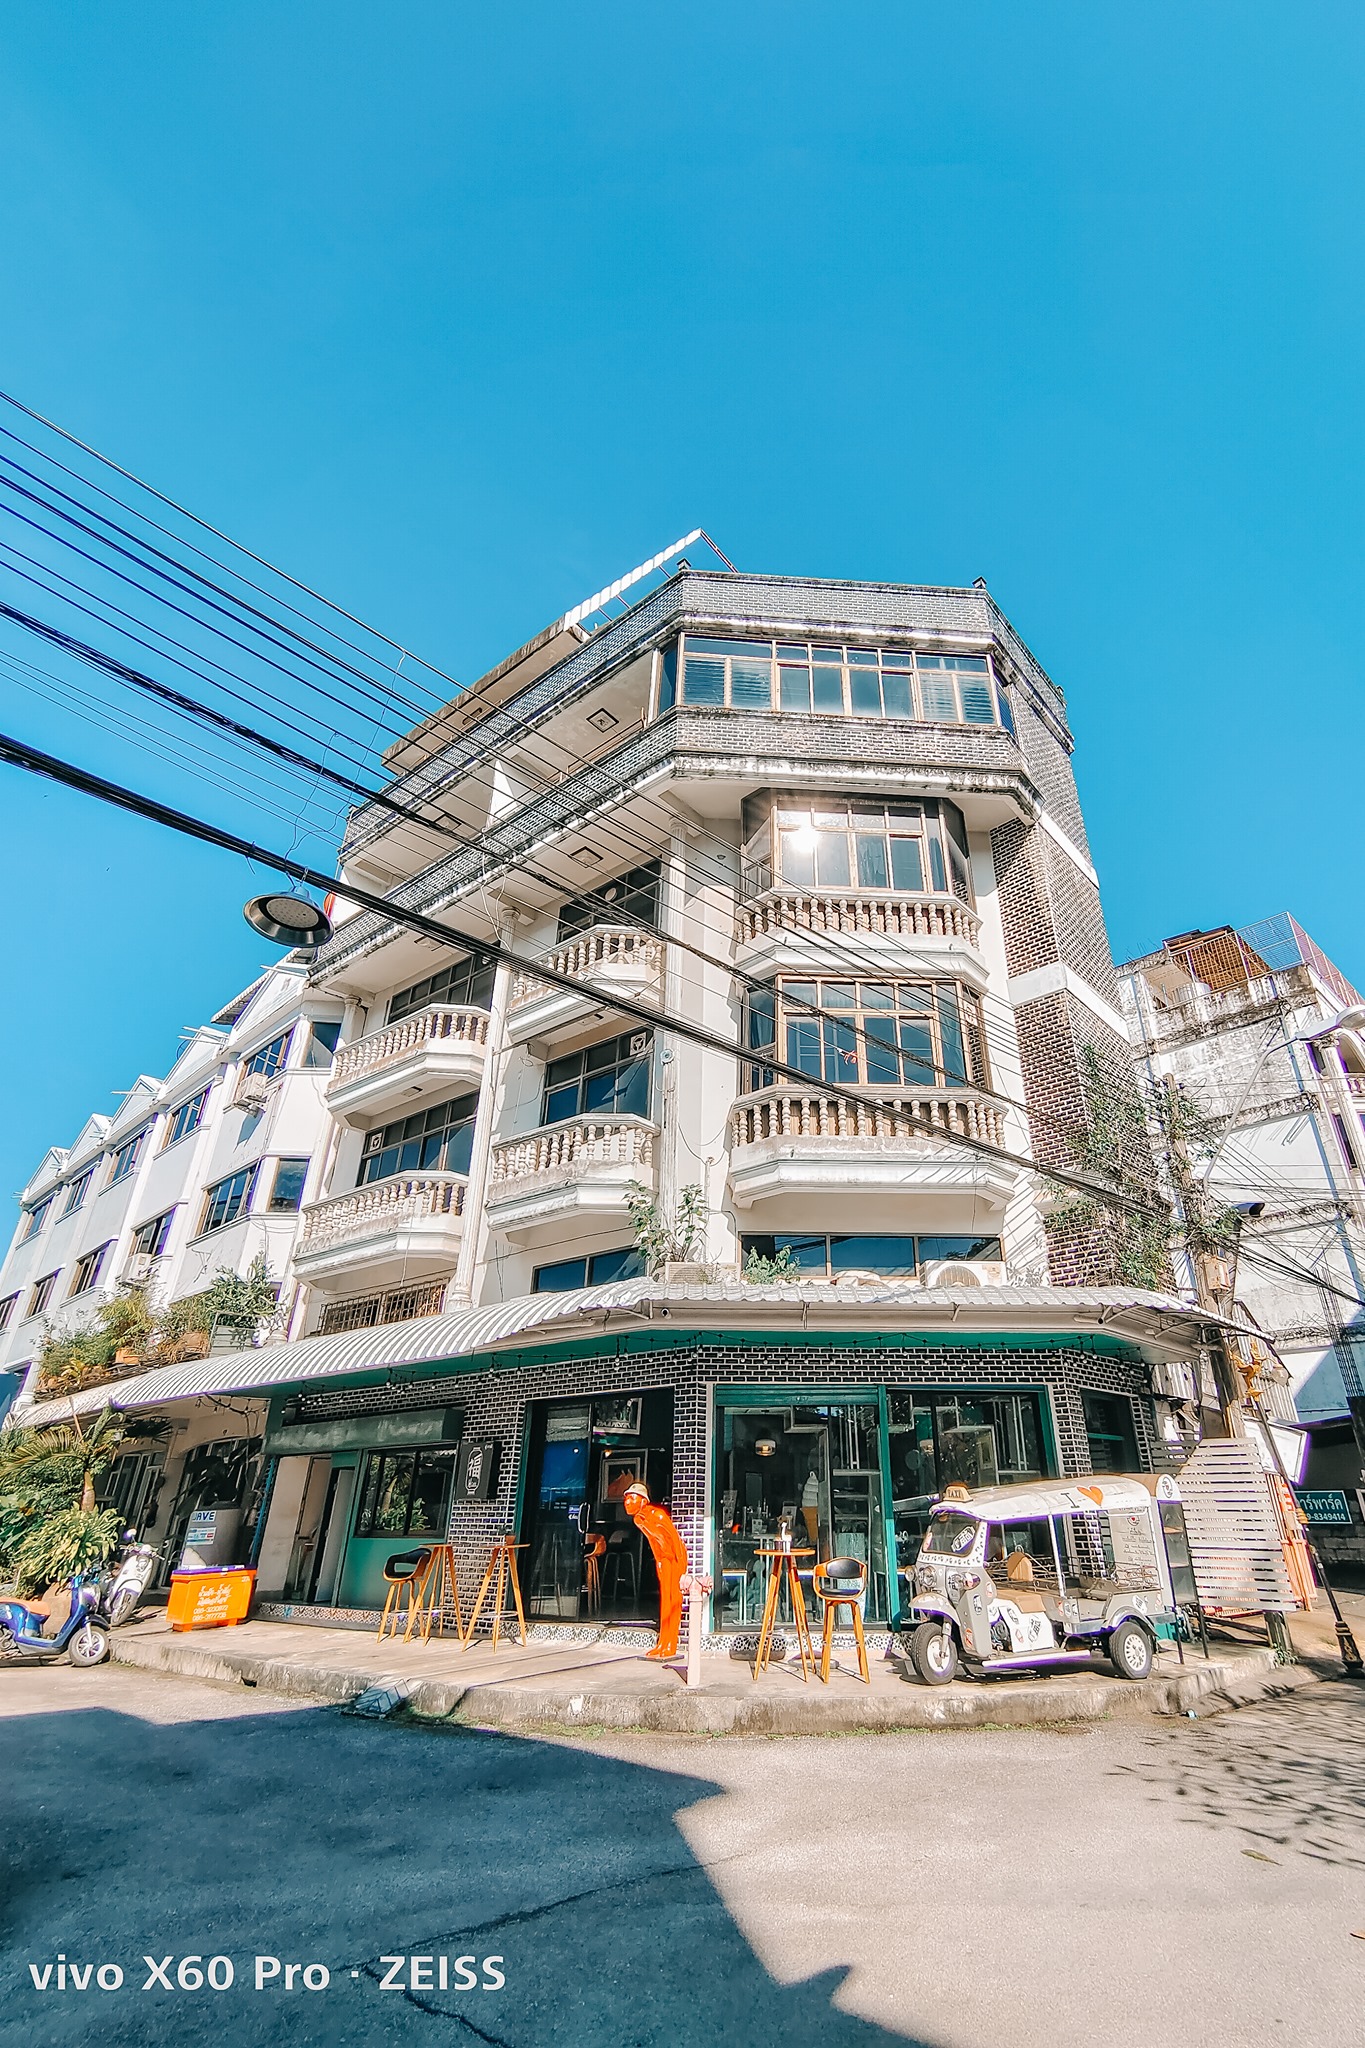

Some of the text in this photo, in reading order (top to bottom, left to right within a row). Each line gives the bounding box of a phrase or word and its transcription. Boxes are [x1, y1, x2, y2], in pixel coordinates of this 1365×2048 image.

[948, 1489, 962, 1498] TAXI
[1299, 1493, 1344, 1510] าร์พาร์ค
[1306, 1512, 1346, 1521] 9-8349414
